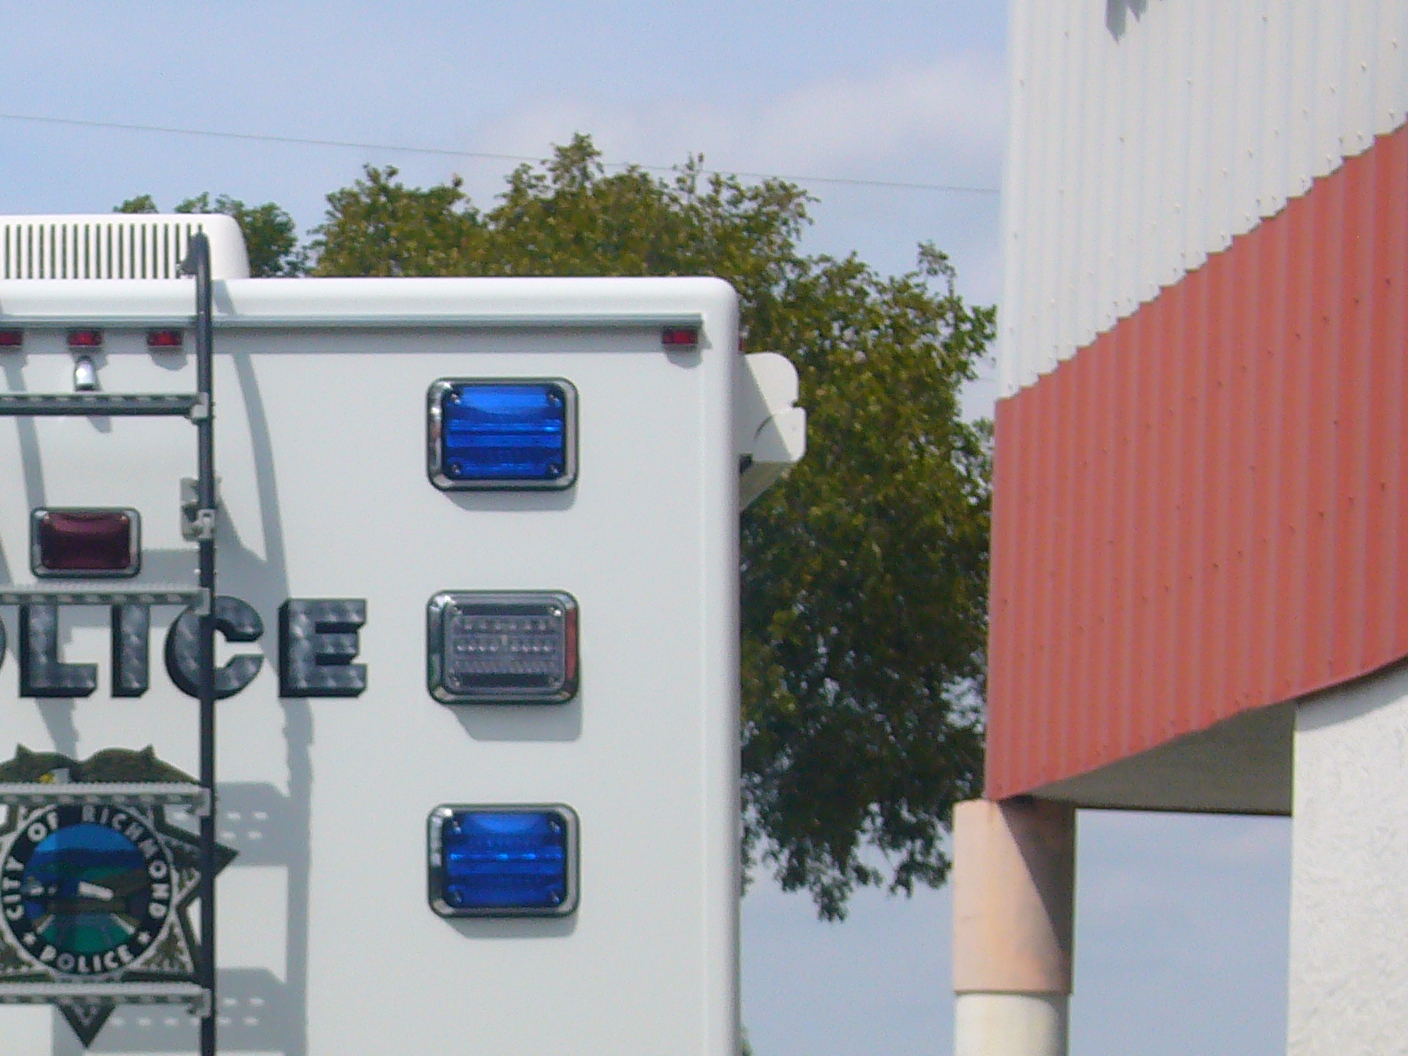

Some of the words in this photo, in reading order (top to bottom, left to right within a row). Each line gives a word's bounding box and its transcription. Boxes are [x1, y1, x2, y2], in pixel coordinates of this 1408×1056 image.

[2, 856, 24, 919] CITY
[27, 811, 60, 843] OF
[82, 805, 169, 919] RICHMOND
[39, 944, 133, 973] POLICE
